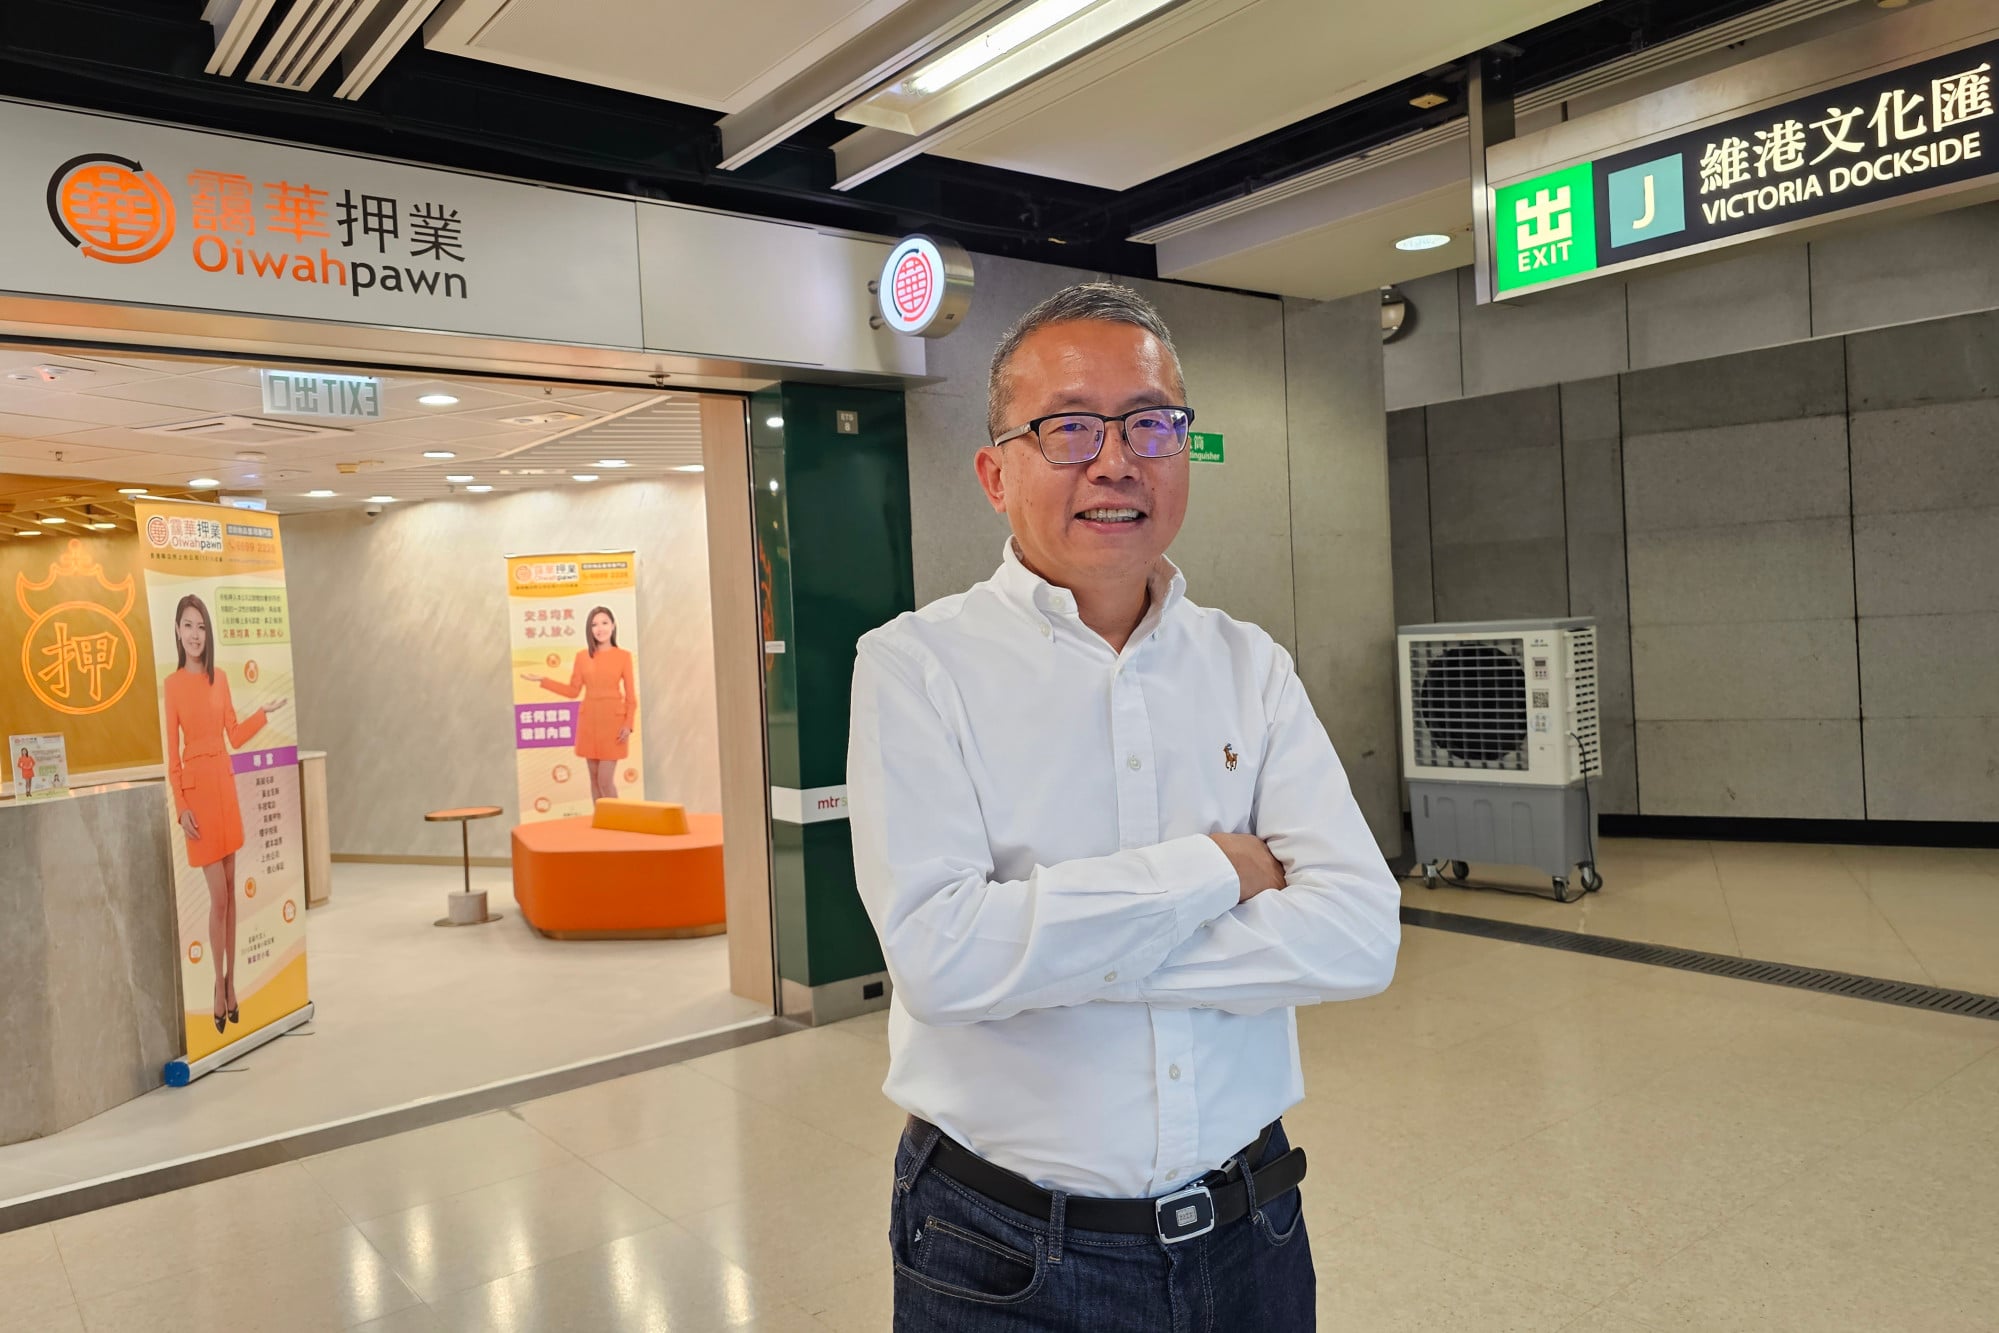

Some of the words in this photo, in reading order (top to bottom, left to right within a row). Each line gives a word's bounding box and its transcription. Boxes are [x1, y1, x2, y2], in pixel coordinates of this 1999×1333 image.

[1699, 62, 1994, 195] 維港文化匯
[1631, 175, 1656, 230] J
[1701, 173, 1824, 226] VICTORIA
[1828, 131, 1983, 194] DOCKSIDE
[1515, 185, 1572, 250] 出
[192, 234, 468, 299] Oiwahpawn
[1517, 240, 1574, 274] EXIT
[38, 622, 118, 702] 押
[817, 796, 840, 809] mtr
